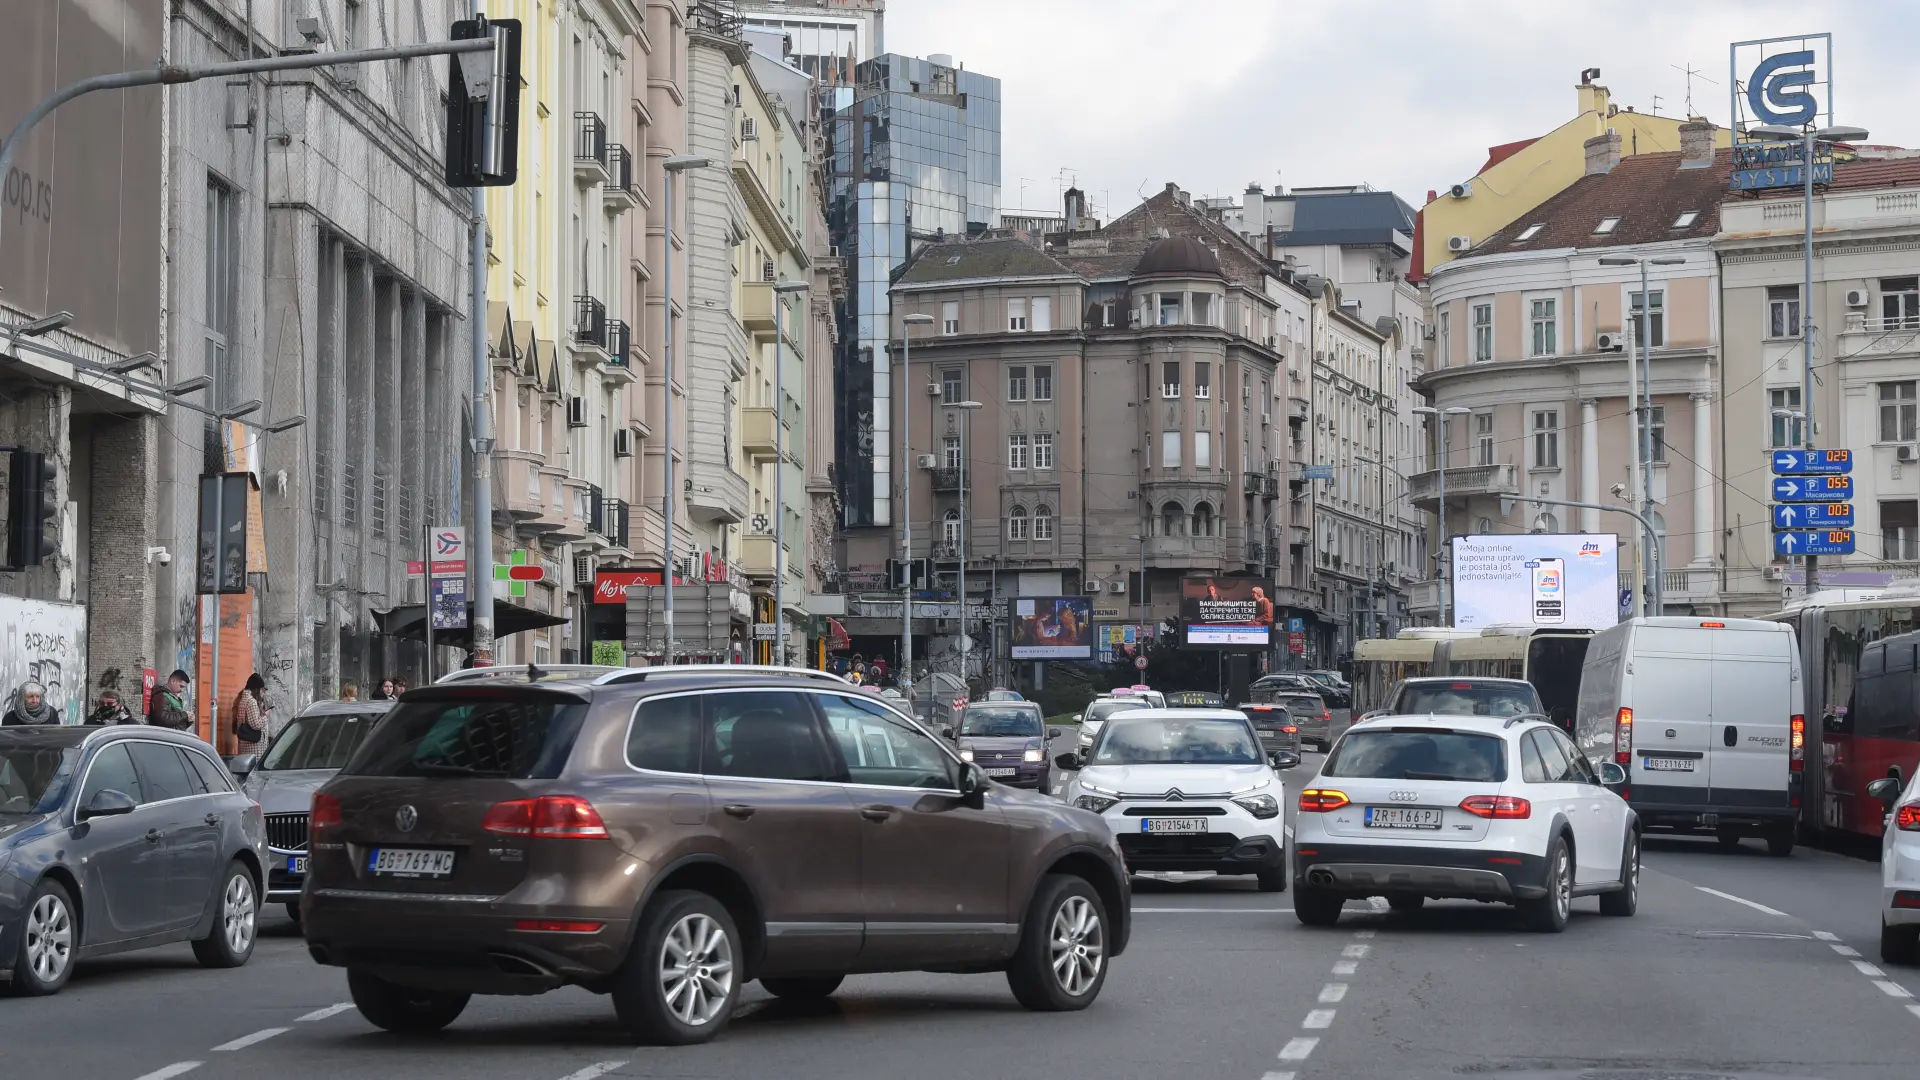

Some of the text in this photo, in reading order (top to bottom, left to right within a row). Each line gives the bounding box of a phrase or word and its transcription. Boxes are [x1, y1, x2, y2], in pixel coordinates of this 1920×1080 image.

[1826, 450, 1848, 462] 029
[1827, 477, 1849, 489] 055
[1827, 504, 1849, 516] 003
[1829, 531, 1850, 543] 004
[1487, 544, 1512, 552] online
[1806, 545, 1842, 554] Славија
[1459, 554, 1495, 562] kupovina
[1459, 562, 1512, 572] je postala još
[597, 580, 619, 597] Moj
[1650, 759, 1659, 768] BG
[1374, 809, 1388, 822] ZR
[1148, 820, 1161, 831] BG
[378, 851, 394, 869] BG
